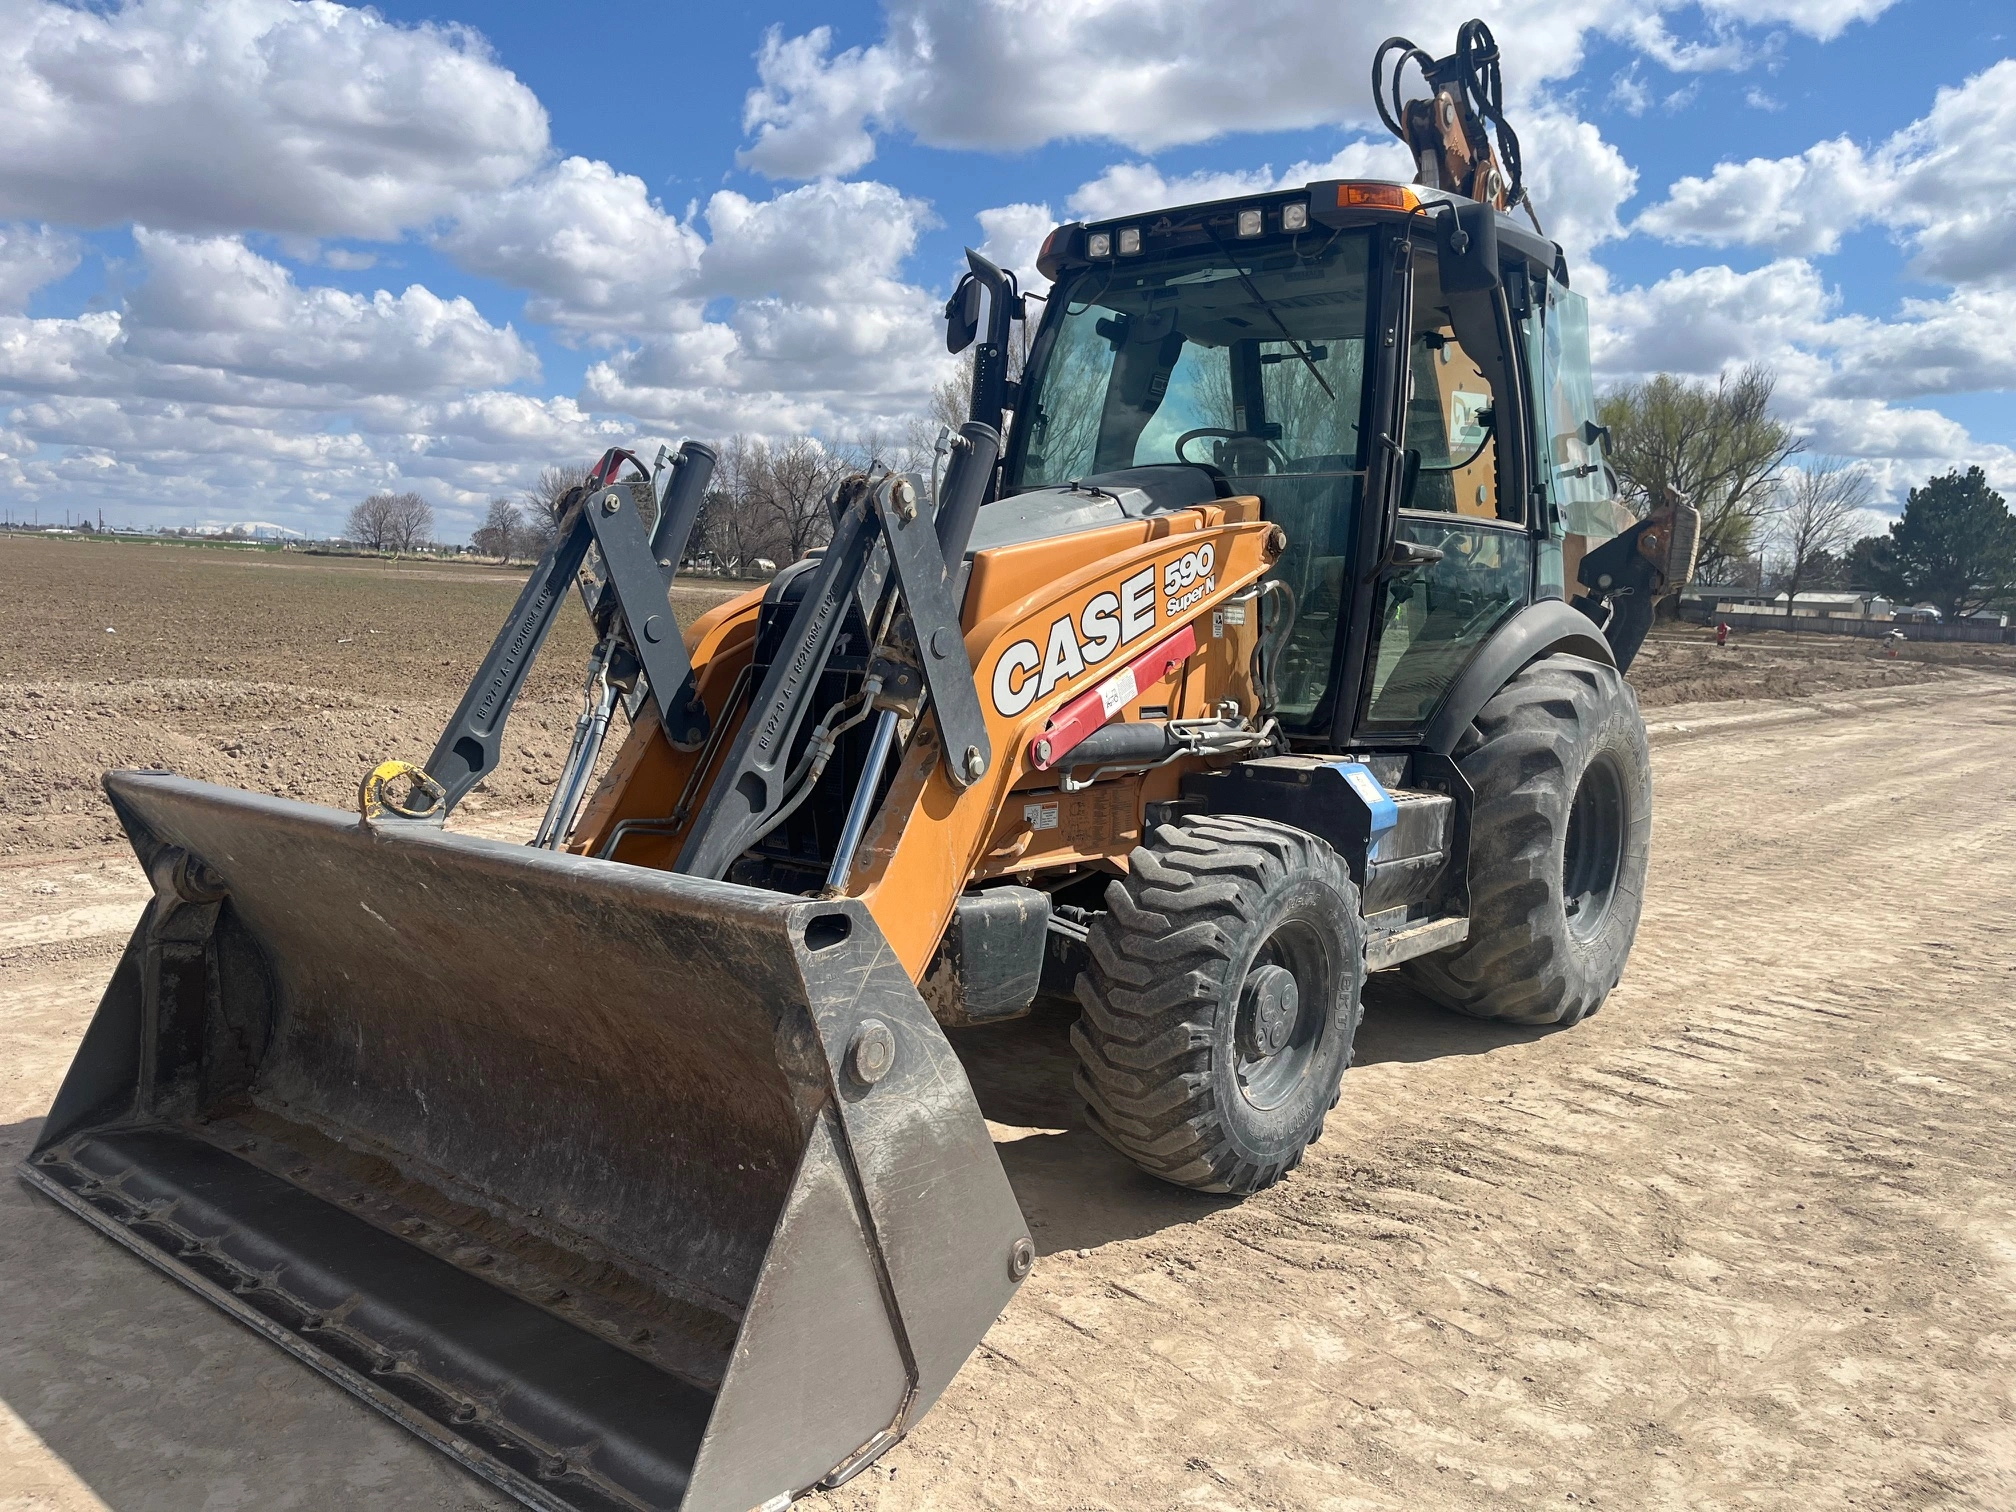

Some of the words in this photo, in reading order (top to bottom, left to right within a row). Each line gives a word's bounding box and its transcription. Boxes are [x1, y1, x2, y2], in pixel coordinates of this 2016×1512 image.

[1163, 542, 1216, 597] 590
[1166, 583, 1205, 617] Super
[1205, 573, 1216, 595] N
[992, 563, 1156, 718] CASE
